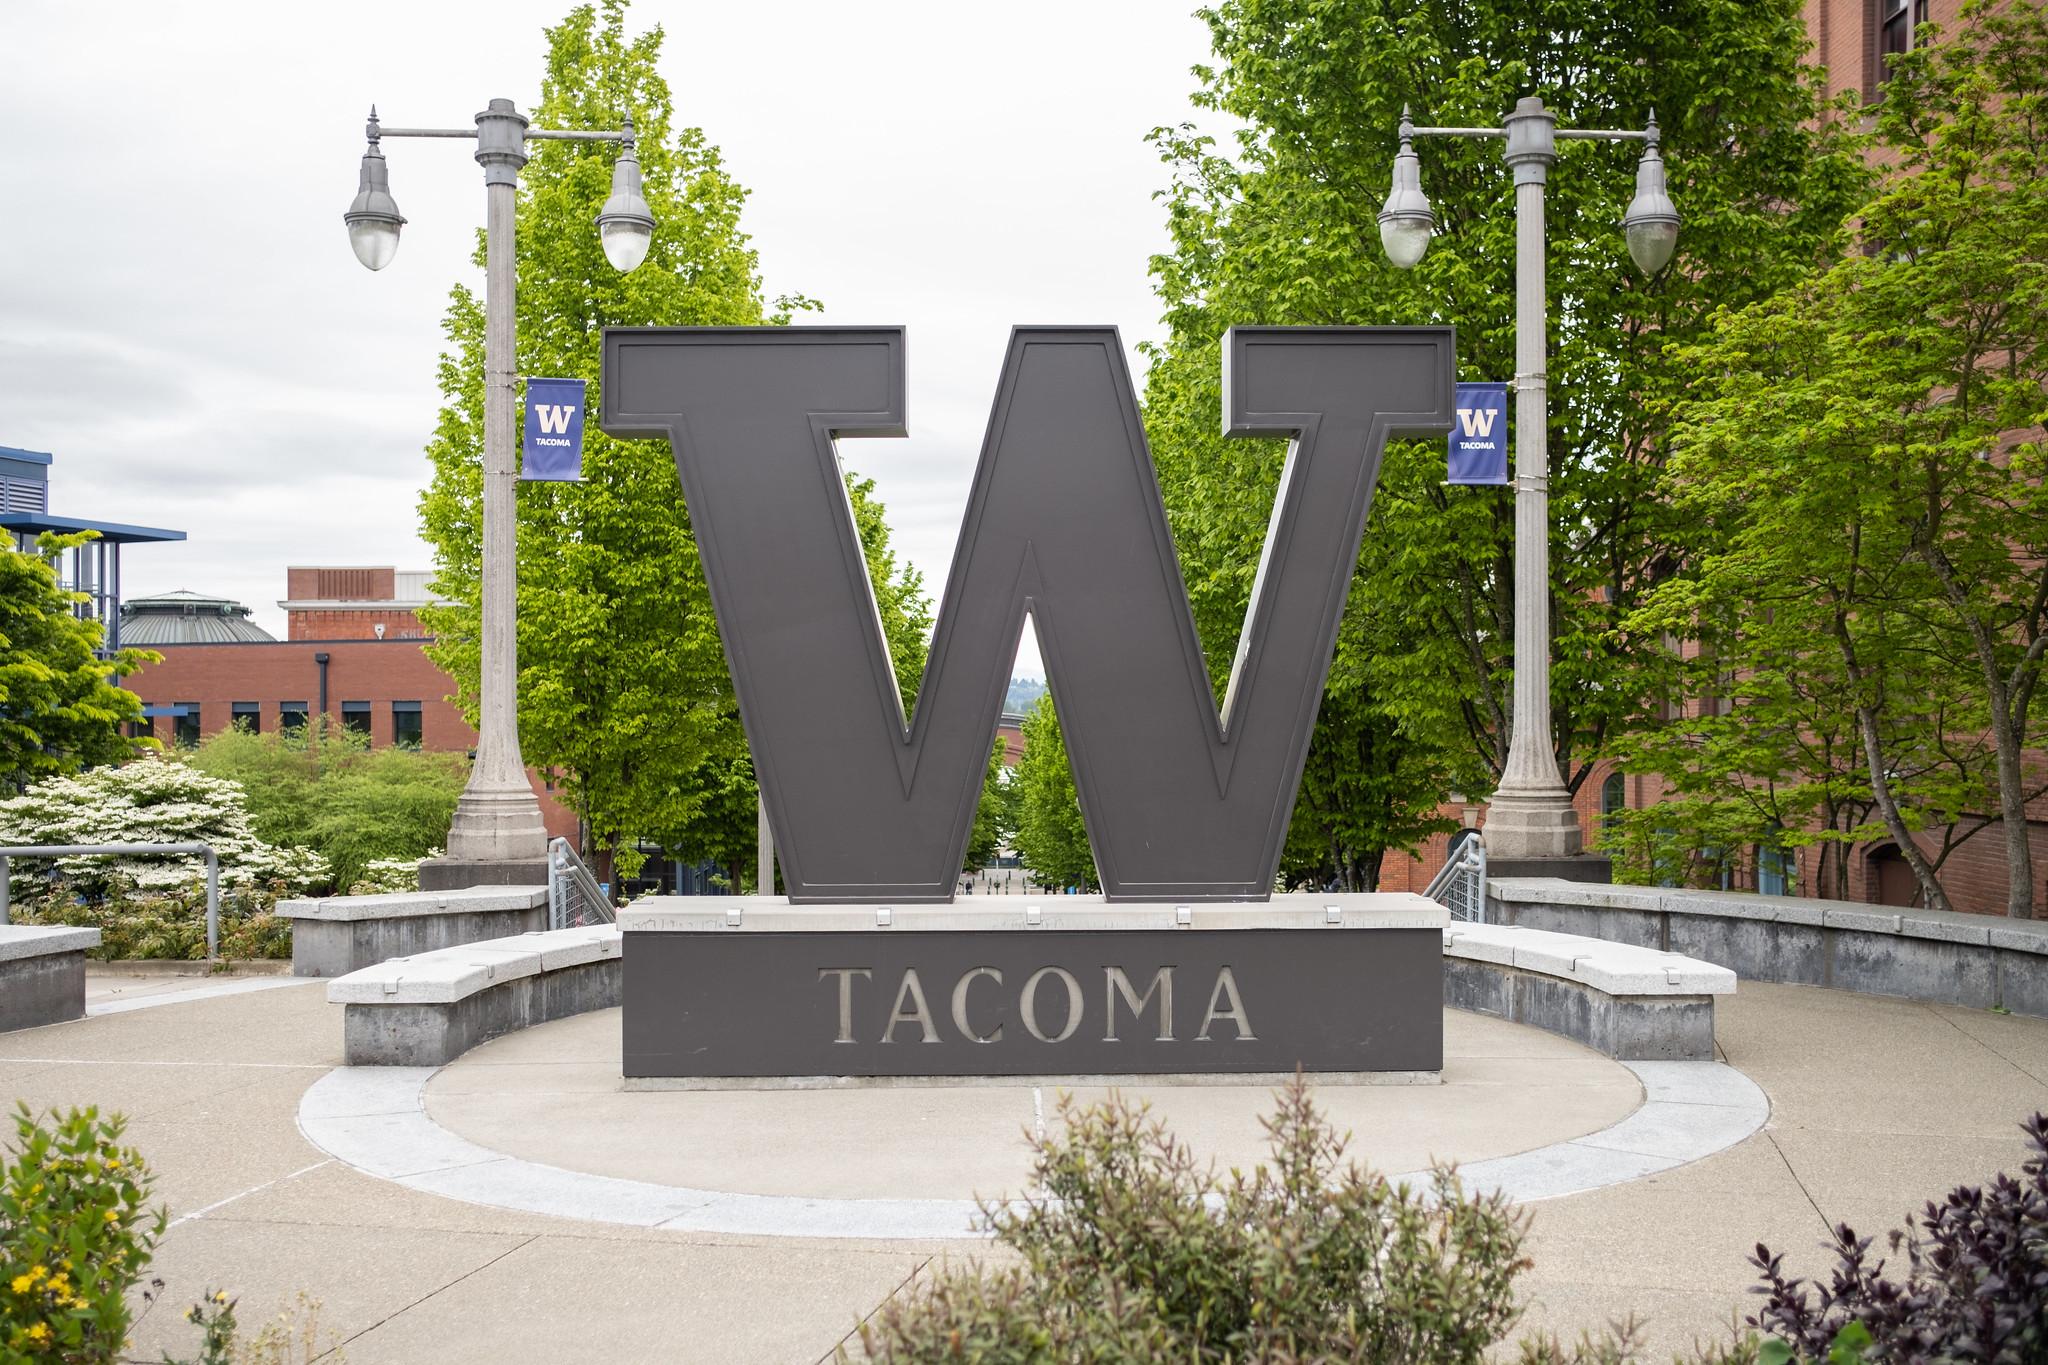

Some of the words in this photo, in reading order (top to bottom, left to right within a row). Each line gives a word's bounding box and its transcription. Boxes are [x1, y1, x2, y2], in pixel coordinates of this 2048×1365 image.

[535, 404, 575, 434] W
[1456, 409, 1498, 437] W
[536, 438, 571, 447] TACOMA
[1459, 442, 1495, 450] TACOMA
[601, 325, 1456, 903] W
[817, 965, 1259, 1044] TACOMA
